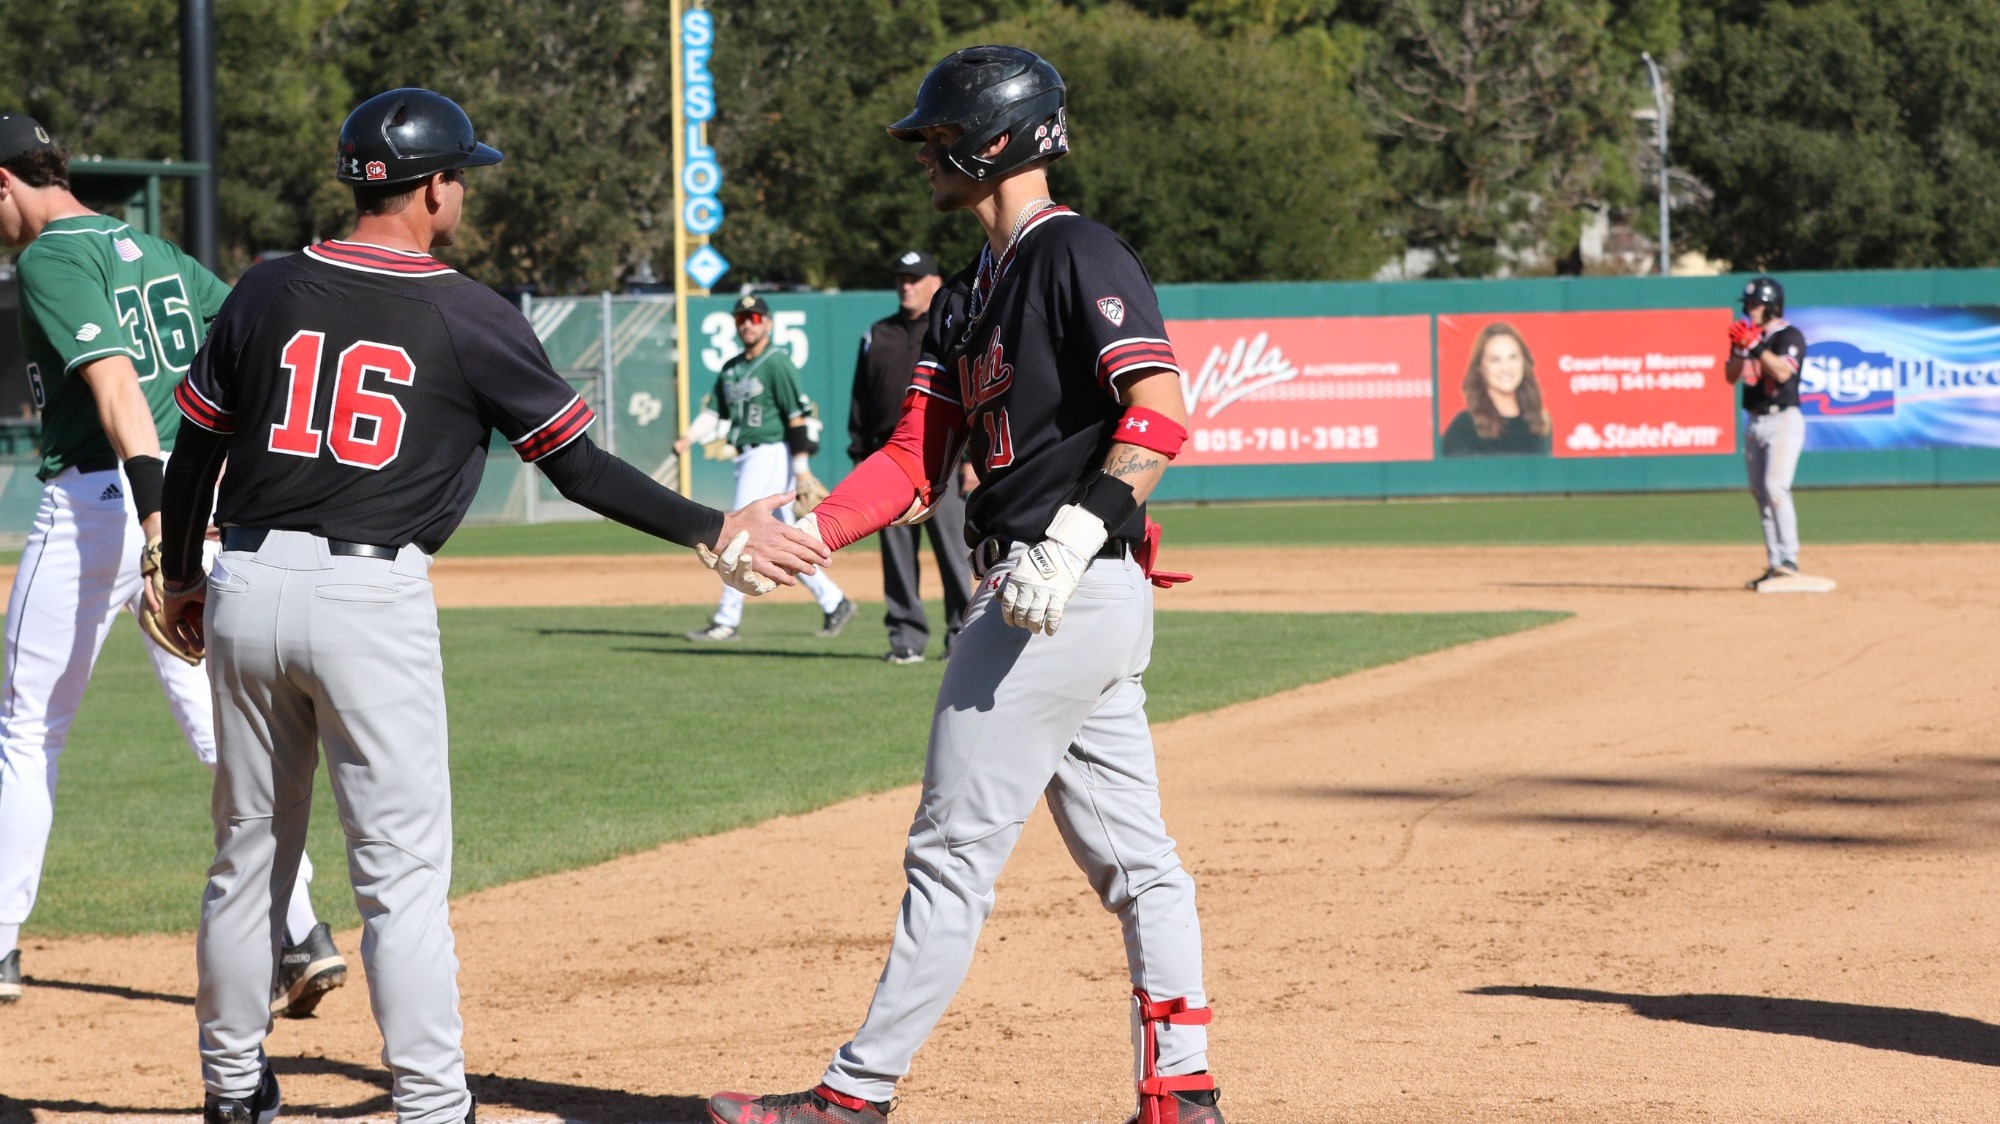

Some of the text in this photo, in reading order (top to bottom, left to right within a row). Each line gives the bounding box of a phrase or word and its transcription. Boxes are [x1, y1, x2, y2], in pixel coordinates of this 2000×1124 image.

[682, 9, 723, 234] SESLOC
[114, 273, 198, 382] 36
[701, 311, 809, 373] 35
[1180, 331, 1298, 417] Villa
[268, 329, 416, 471] 16
[1194, 426, 1379, 451] 805-781-3925
